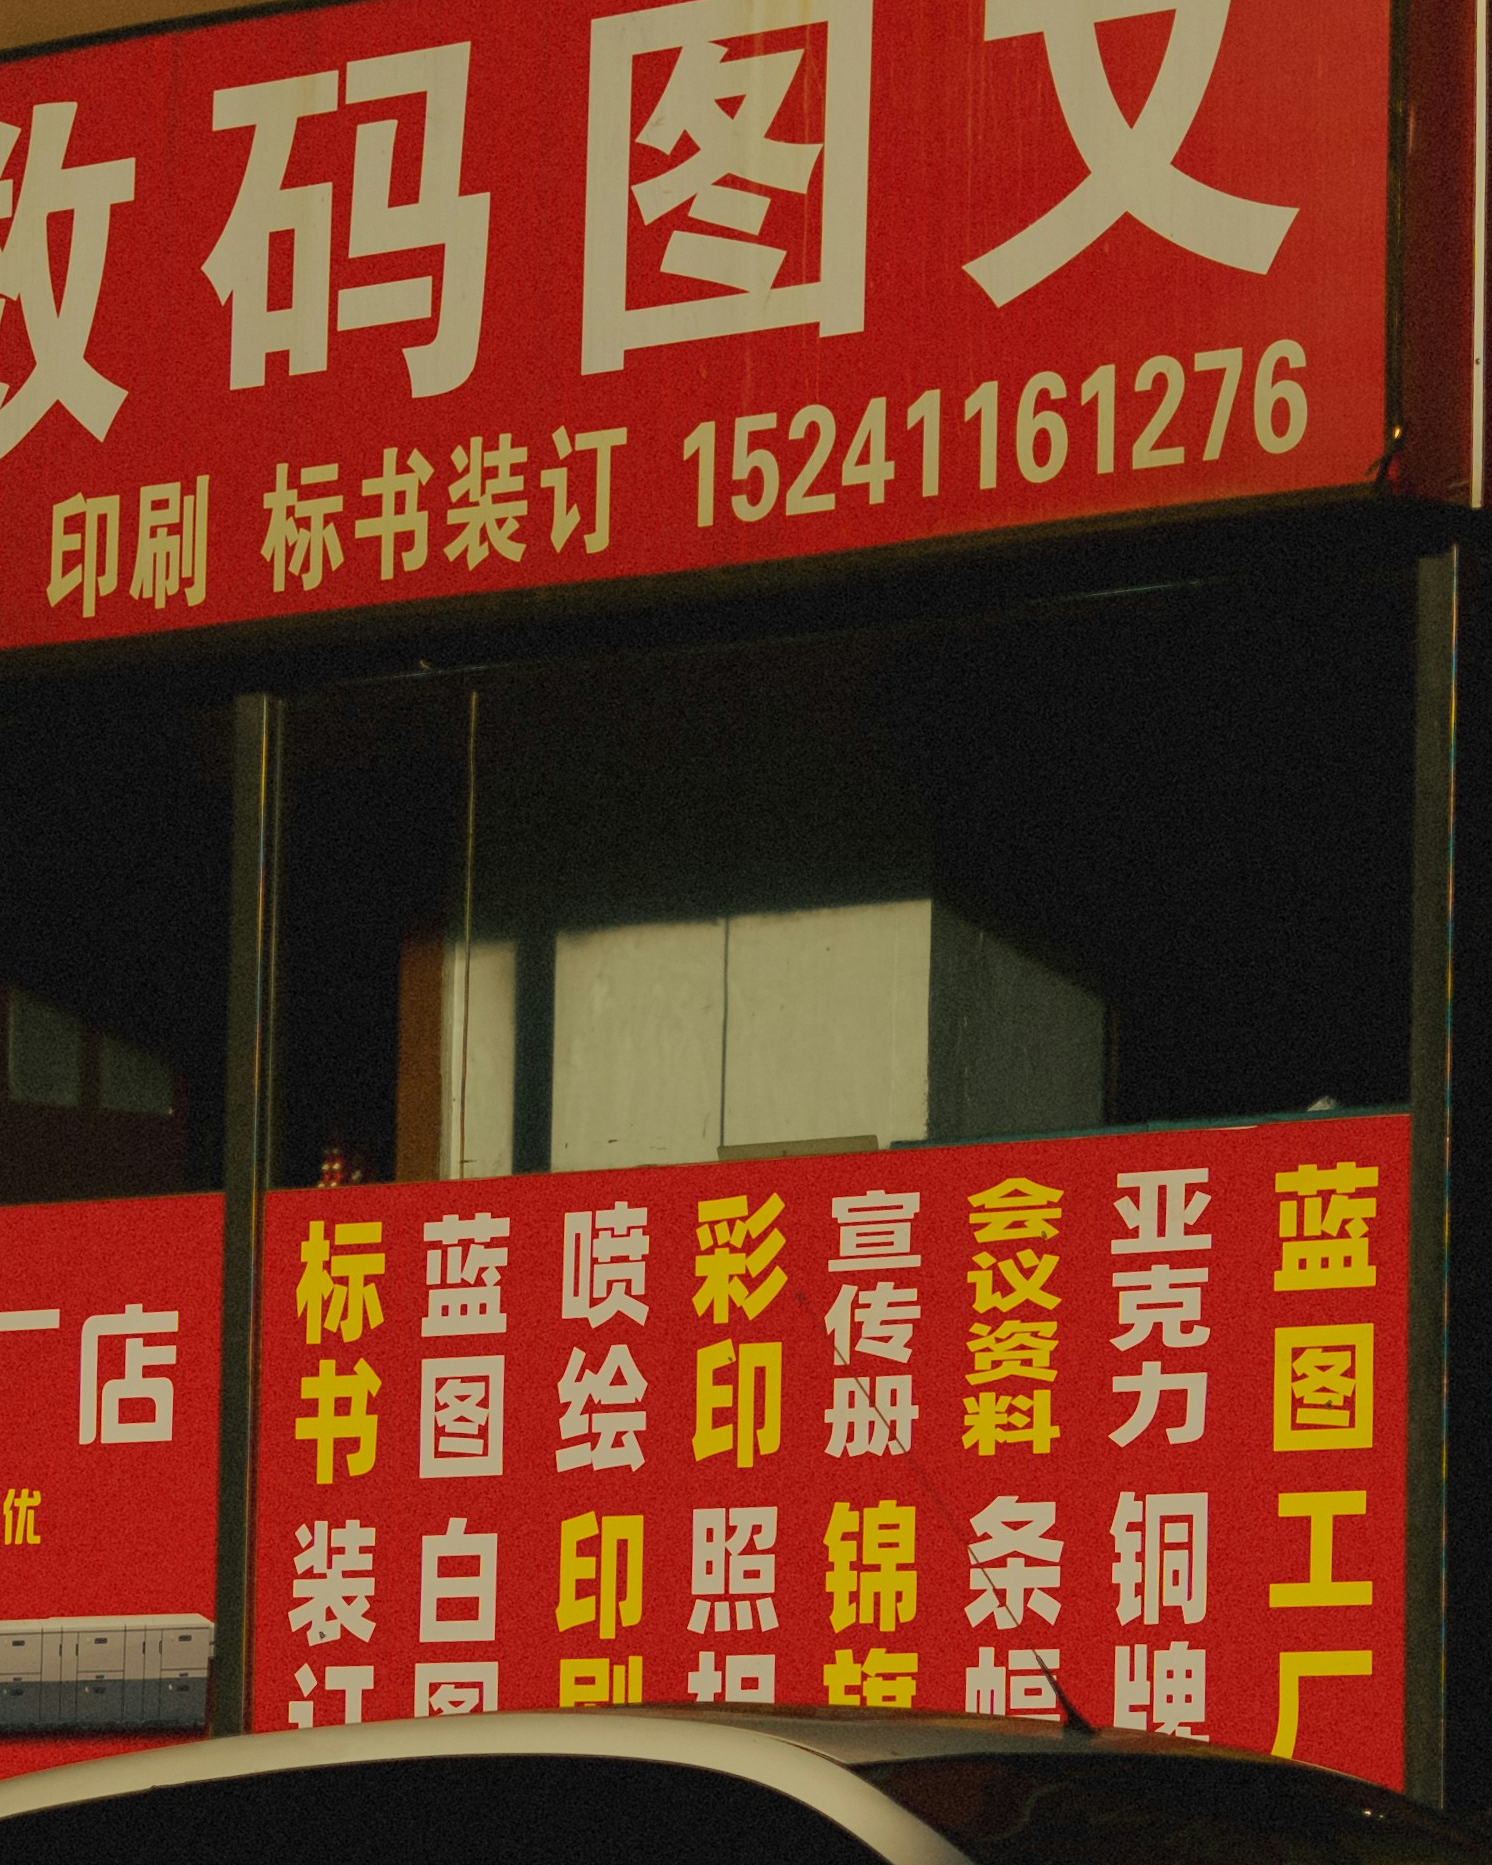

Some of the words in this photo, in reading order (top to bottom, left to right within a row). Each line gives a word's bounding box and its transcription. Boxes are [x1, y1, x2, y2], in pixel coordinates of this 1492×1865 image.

[46, 474, 210, 618] 印刷
[262, 426, 627, 592] 标书装订
[682, 339, 1308, 528] 15241161276
[295, 1220, 386, 1484] 标书
[419, 1212, 510, 1479] 蓝图
[555, 1201, 650, 1472] 喷绘
[692, 1192, 788, 1468] 彩印
[824, 1190, 922, 1458] 宣传册
[962, 1177, 1065, 1456] 会议资料
[1109, 1167, 1212, 1448] 亚克力
